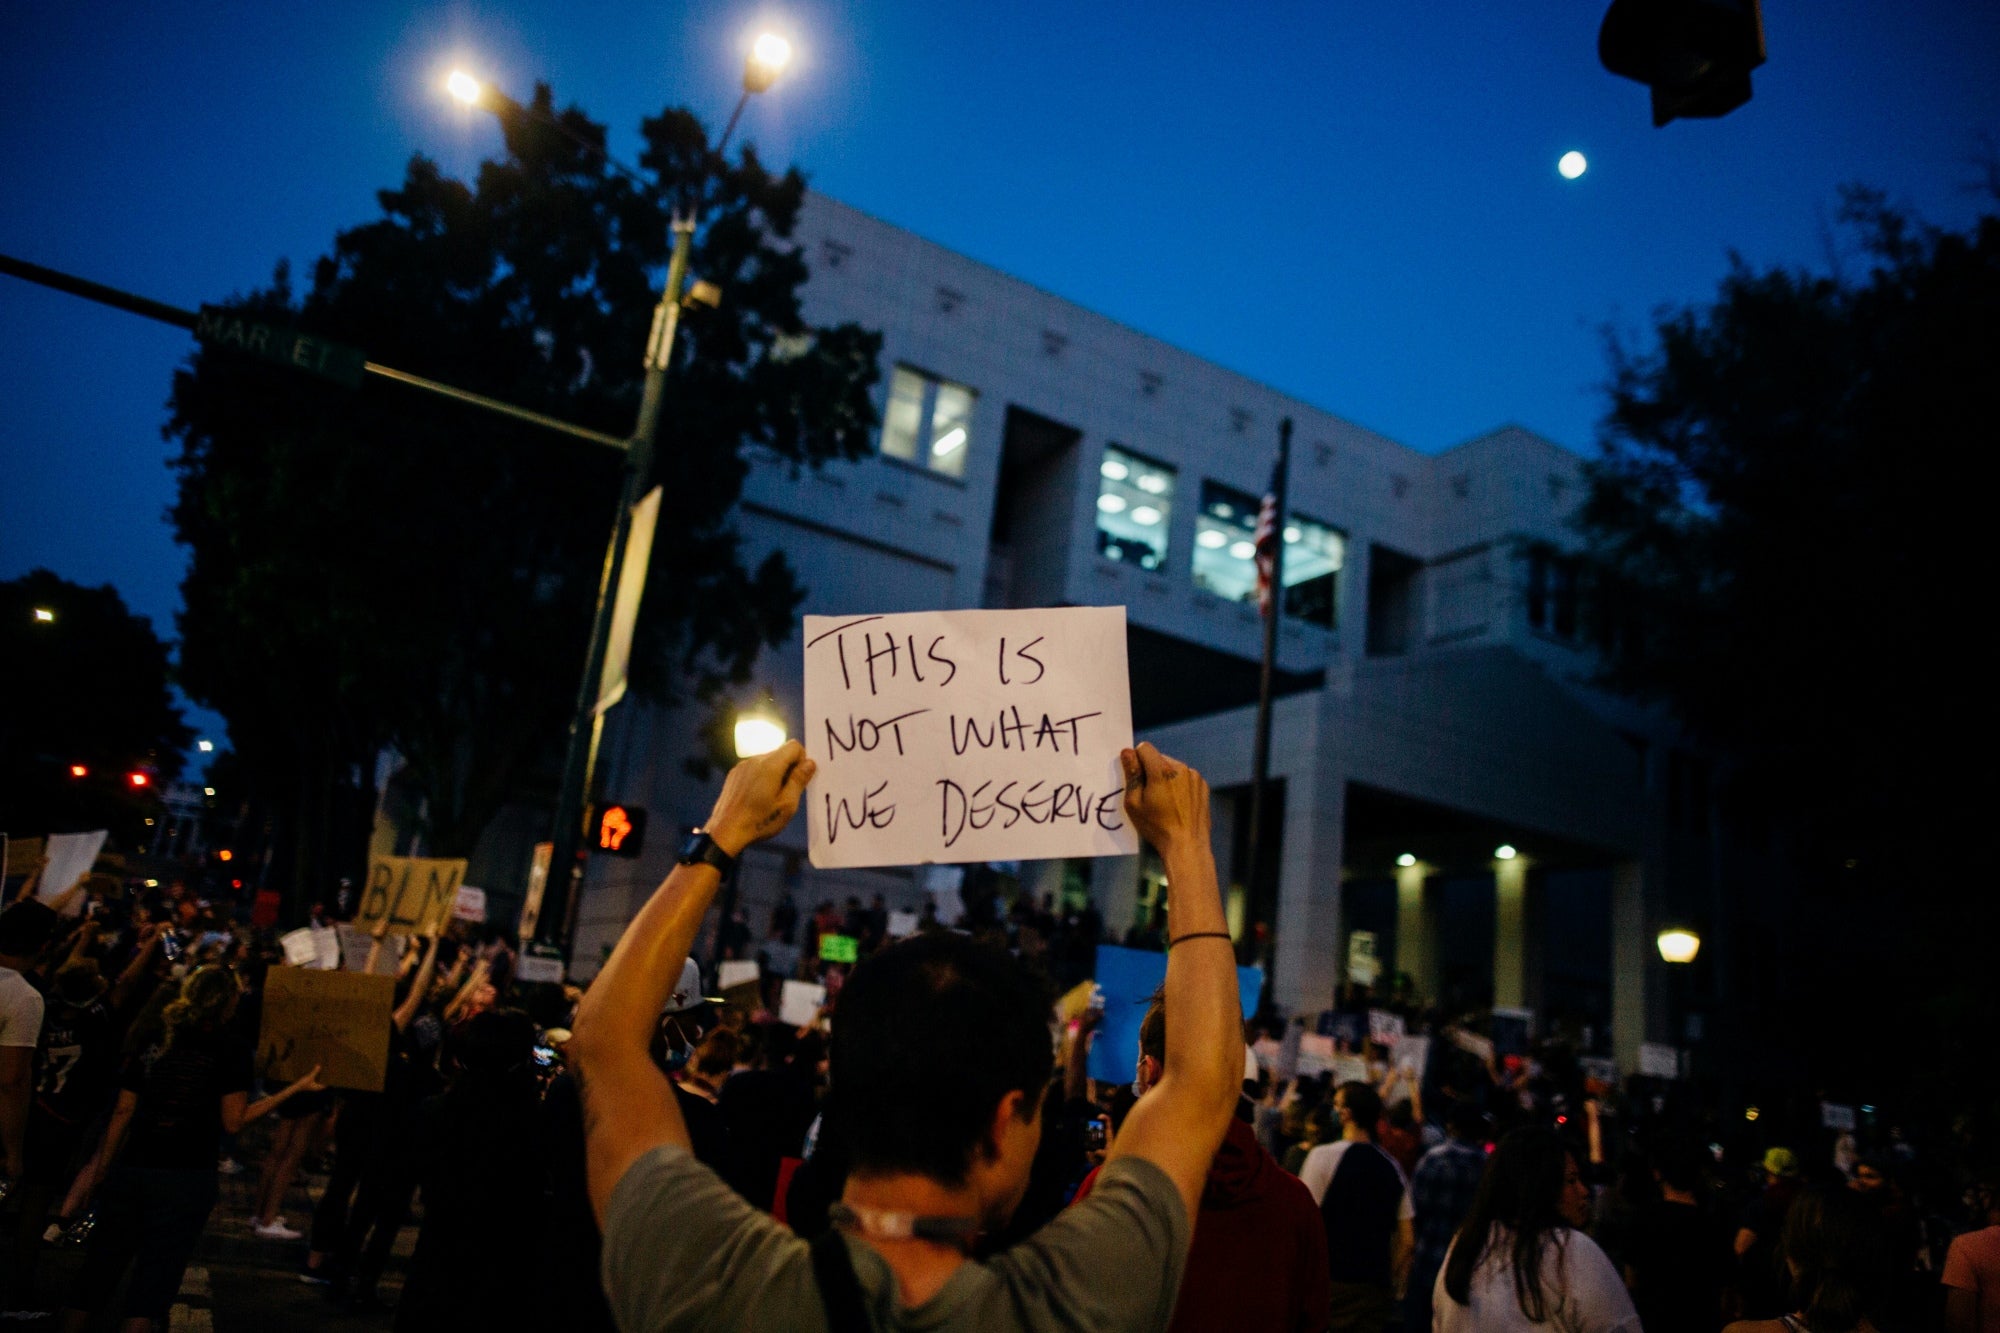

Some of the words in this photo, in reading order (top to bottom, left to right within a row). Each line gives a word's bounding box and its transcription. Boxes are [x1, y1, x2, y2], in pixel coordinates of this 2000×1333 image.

[197, 311, 334, 375] MARET
[806, 616, 957, 696] THIS
[999, 636, 1045, 686] IS
[824, 708, 933, 761] NOT
[949, 705, 1103, 756] WHAT
[824, 780, 897, 844] WE
[935, 779, 1125, 848] DESERVE
[363, 863, 459, 927] BLM
